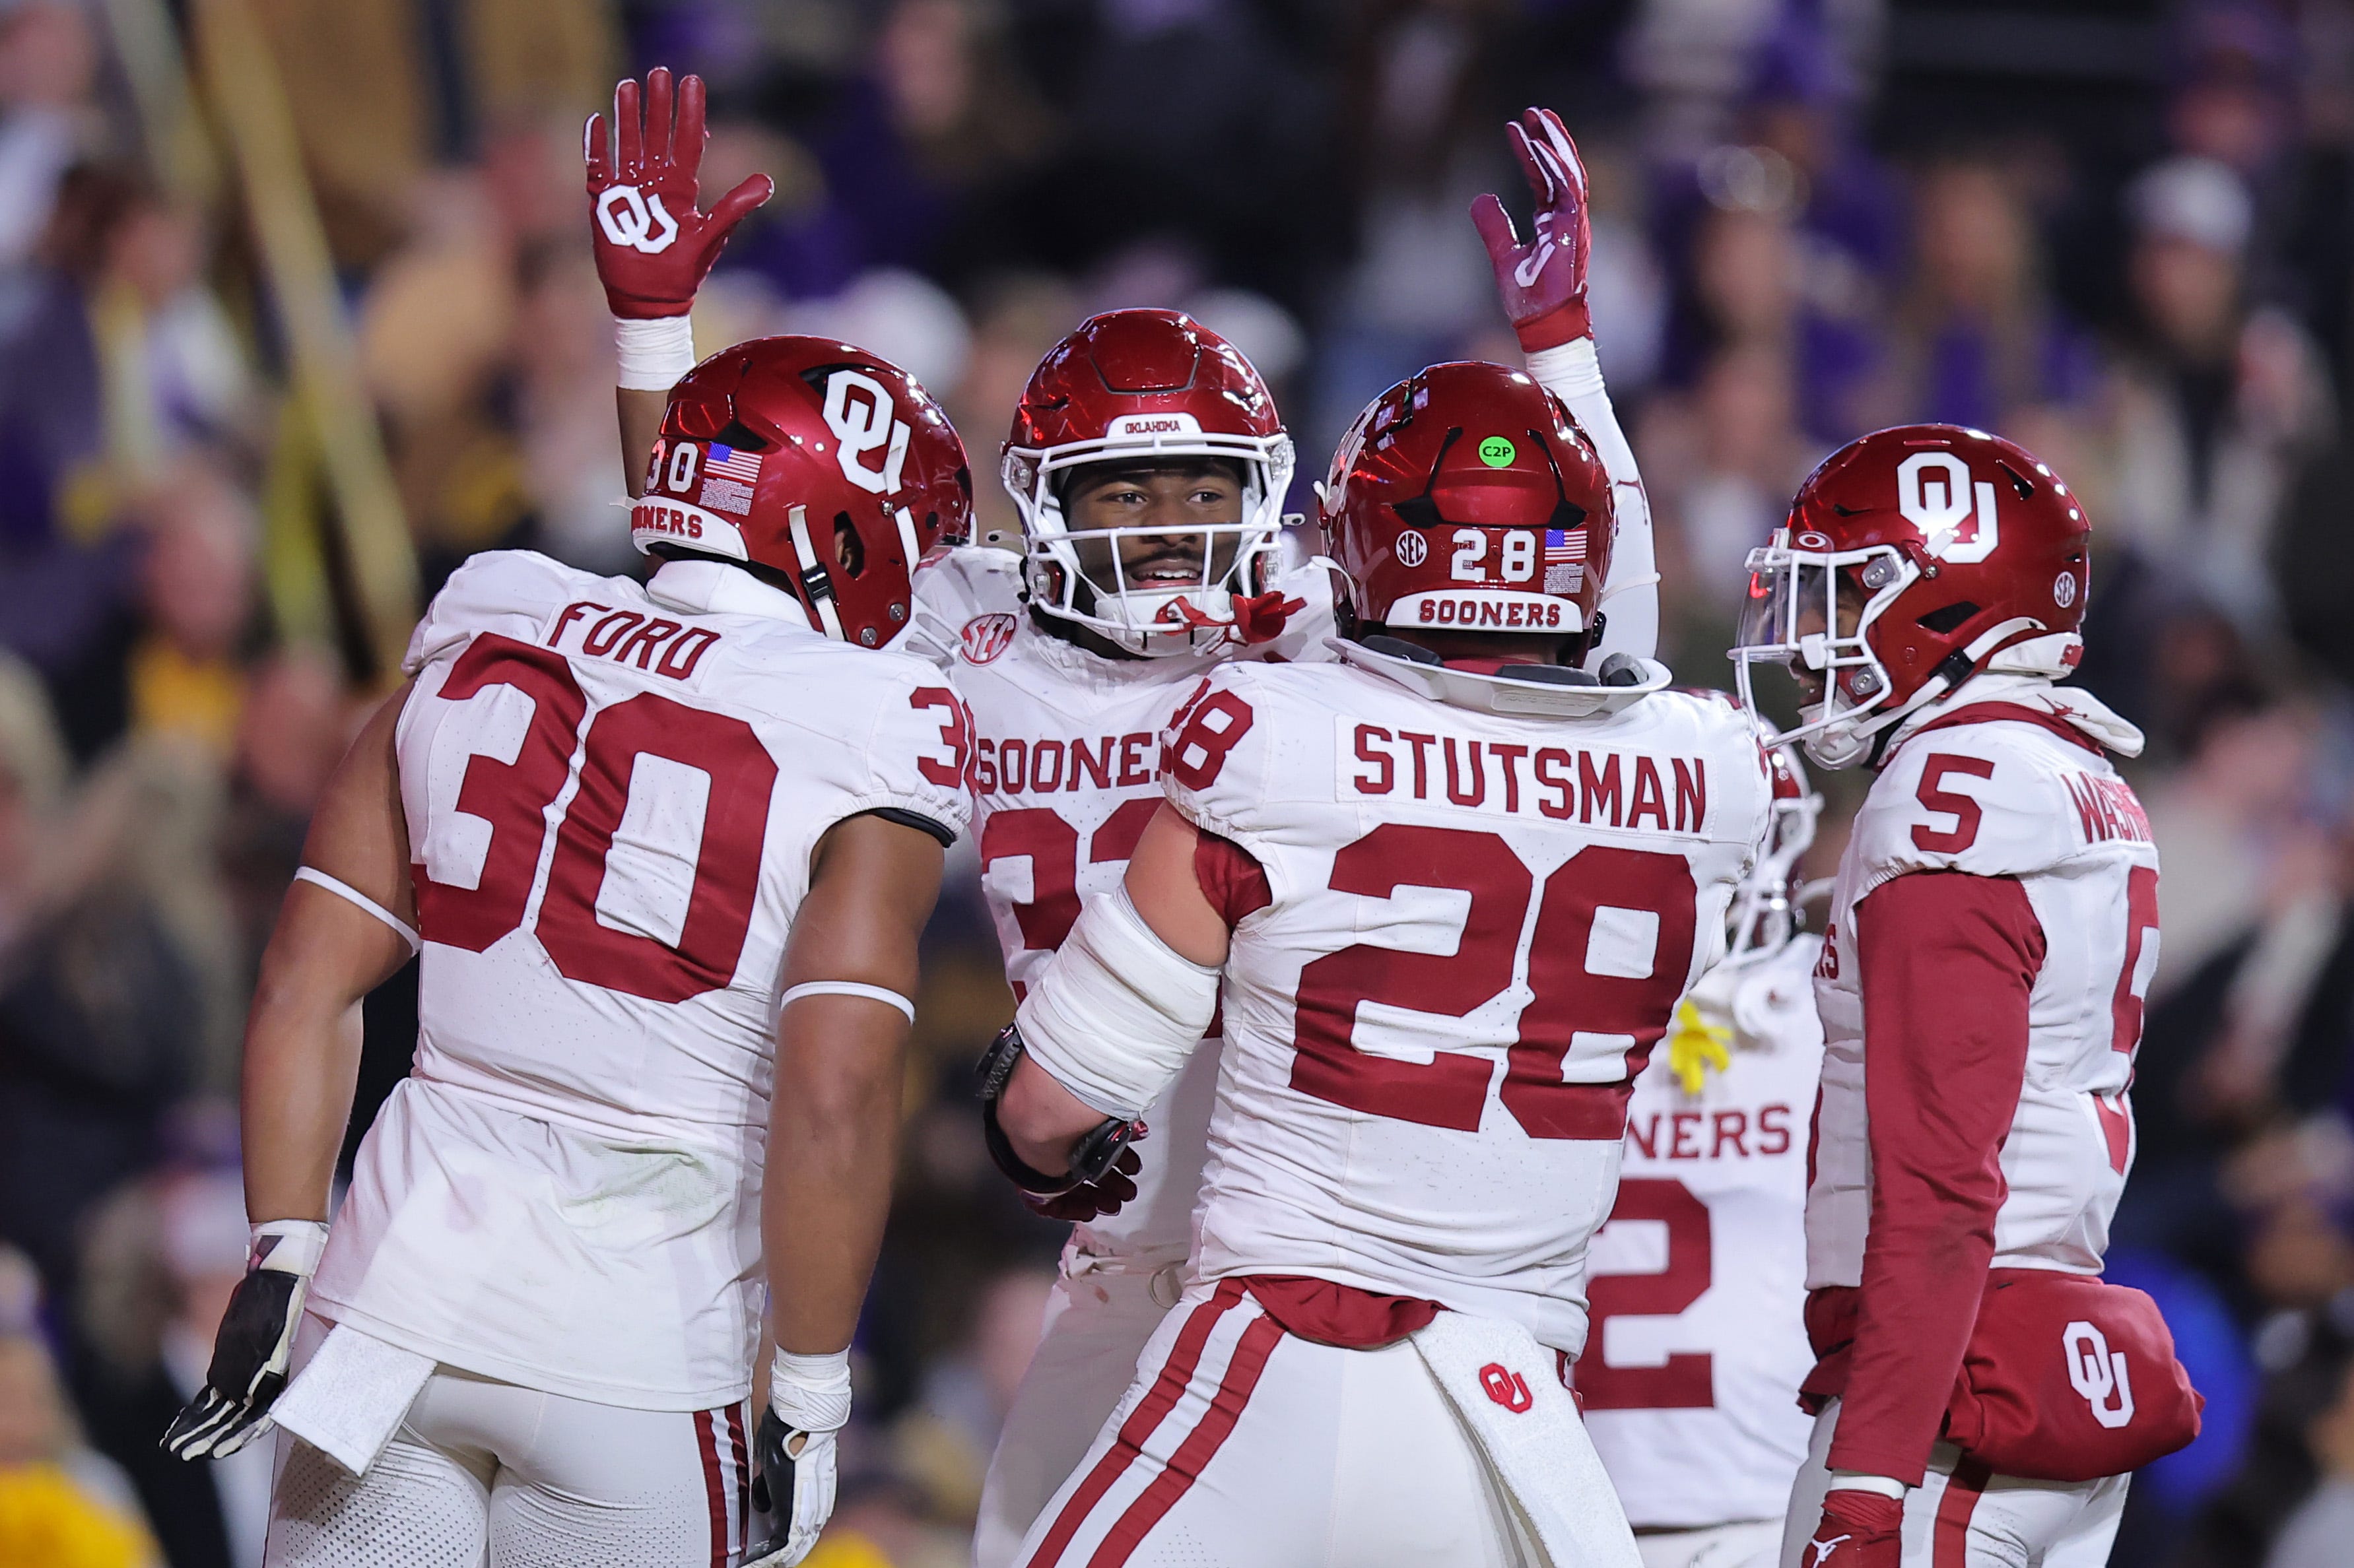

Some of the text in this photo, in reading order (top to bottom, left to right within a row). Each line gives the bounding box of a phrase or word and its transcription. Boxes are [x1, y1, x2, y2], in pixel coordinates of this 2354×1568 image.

[596, 183, 679, 253] OU
[823, 369, 911, 494] OU
[1125, 420, 1181, 434] OKLAHOMA
[1482, 445, 1512, 458] C2P
[632, 504, 703, 539] NERS
[1897, 451, 1999, 564] OU
[1397, 531, 1427, 566] SEC
[1450, 528, 1537, 583] 28
[547, 601, 721, 680] FORD
[961, 614, 1018, 663] SEC
[1419, 599, 1561, 627] SOONERS
[978, 730, 1167, 795] SOONE
[1354, 723, 1705, 833] STUTSMAN
[411, 632, 779, 1004] 30
[1910, 752, 1995, 855] 5
[1289, 822, 1698, 1140] 28
[1627, 1100, 1790, 1159] NERS
[2063, 1320, 2136, 1429] OU
